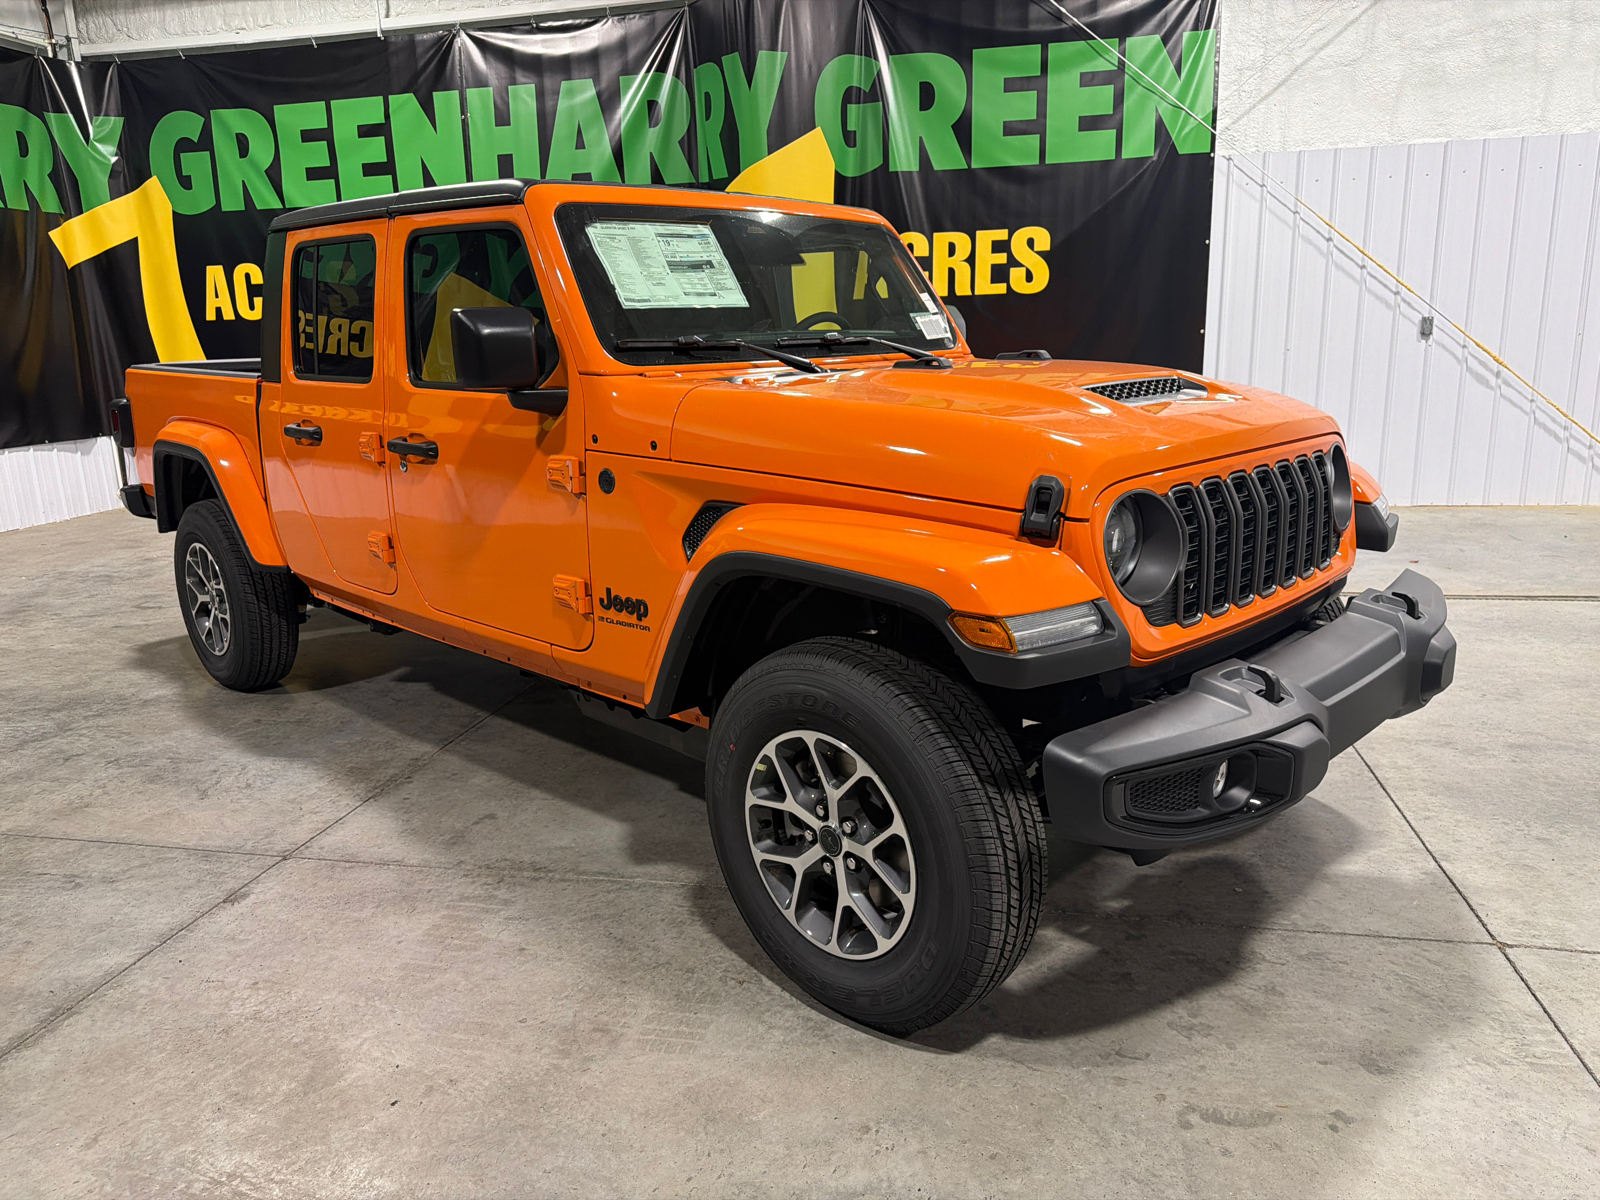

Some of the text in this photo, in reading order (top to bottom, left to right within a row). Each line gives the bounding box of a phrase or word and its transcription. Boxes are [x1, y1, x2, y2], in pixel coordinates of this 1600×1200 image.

[815, 29, 1216, 178] GREEN
[149, 90, 467, 214] GREEN
[599, 587, 649, 622] Jeep
[605, 617, 651, 633] GLADIATOR
